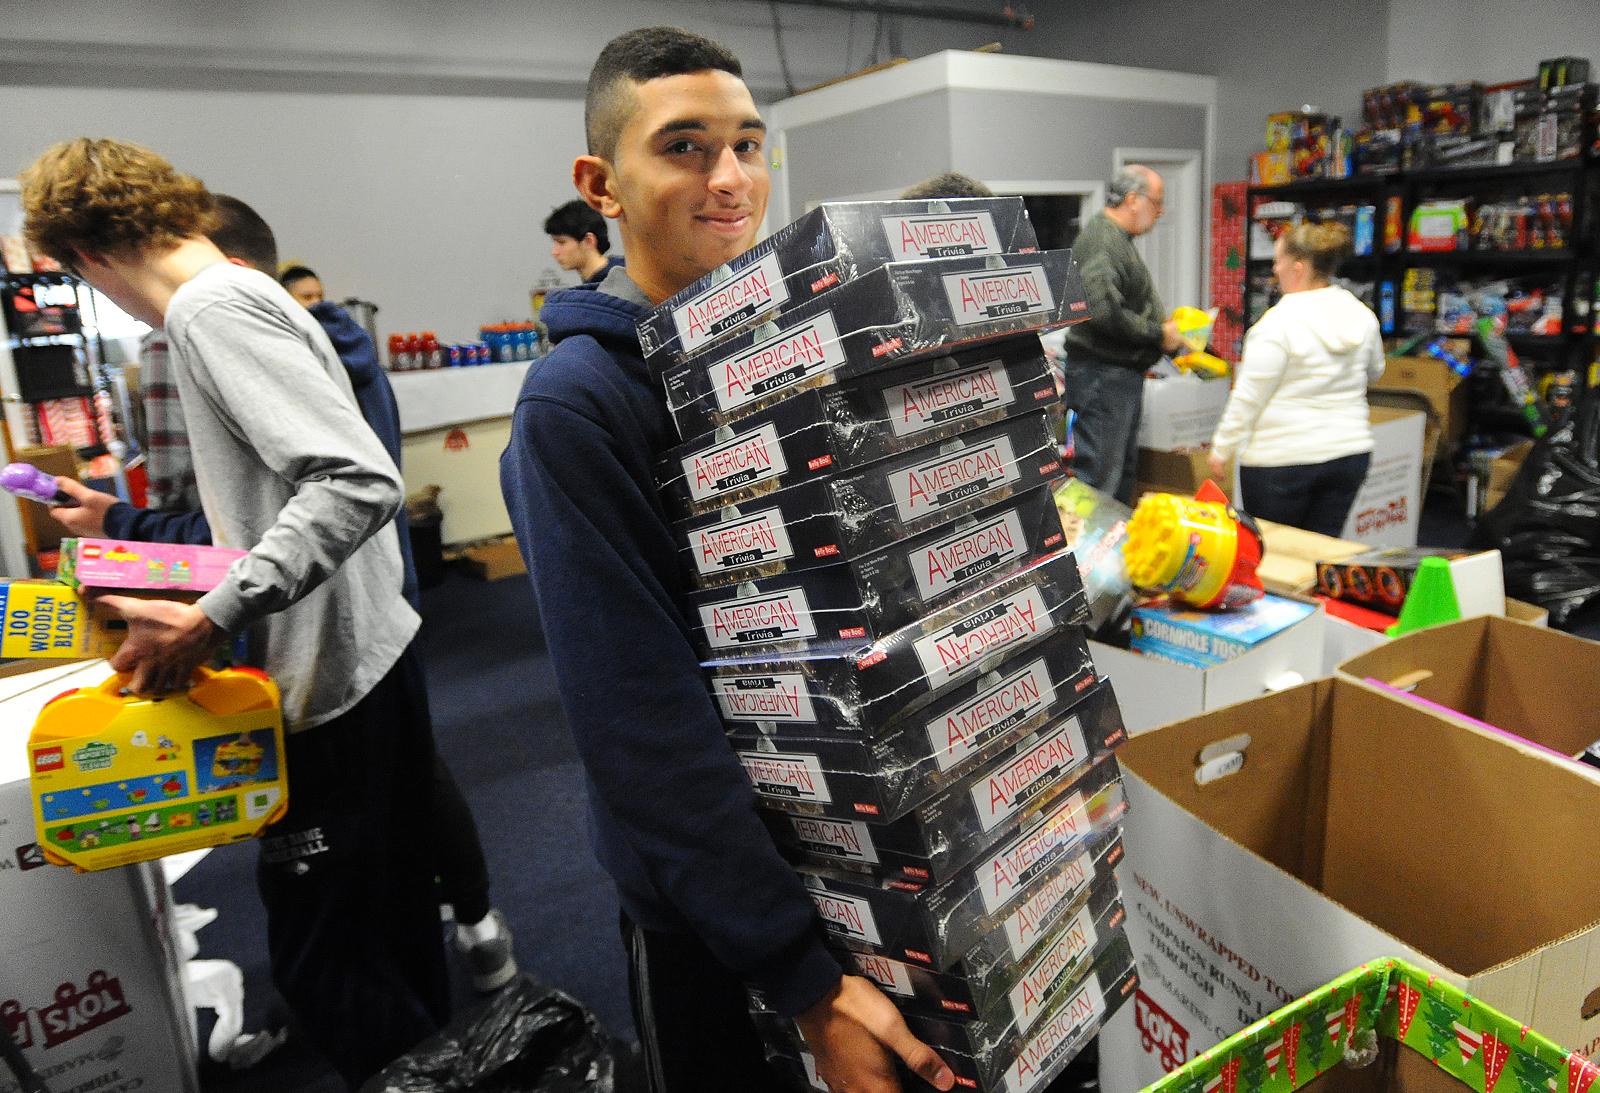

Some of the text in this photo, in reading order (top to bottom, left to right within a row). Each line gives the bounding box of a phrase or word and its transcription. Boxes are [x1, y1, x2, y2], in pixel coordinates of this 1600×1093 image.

[902, 220, 987, 253] AMERICAN
[936, 246, 965, 258] Trivia
[687, 270, 771, 339] AMERICAN
[960, 276, 1041, 312] AMERICAN
[995, 303, 1021, 316] Trivia
[718, 310, 748, 331] Trivia
[725, 331, 824, 397] AMERICAN
[761, 369, 795, 391] Trivia
[903, 371, 998, 422] AMERICAN
[941, 404, 973, 420] Trivia
[695, 439, 771, 489] AMERICAN
[722, 474, 749, 488] Trivia
[909, 449, 1004, 507] AMERICAN
[949, 484, 980, 501] Trivia
[701, 522, 777, 563] AMERICAN
[729, 553, 756, 564] Trivia
[928, 523, 1014, 585] AMERICAN
[964, 560, 993, 577] Trivia
[9, 610, 30, 636] 100
[30, 595, 54, 651] WOODEN
[54, 601, 77, 647] BLOCKS
[713, 600, 799, 638] AMERICAN
[744, 630, 774, 642] Trivia
[937, 599, 1038, 672] AMERICAN
[964, 610, 1000, 629] Trivia
[1145, 617, 1209, 653] CORNHOLE
[724, 686, 799, 717] AMERICAN
[741, 681, 769, 689] Trivia
[946, 674, 1040, 754] AMERICAN
[986, 717, 1017, 741] Trivia
[746, 761, 814, 792] MERICAN
[990, 732, 1075, 815] AMERICAN
[1023, 774, 1054, 798] Trivia
[993, 808, 1077, 898] AMERICAN
[1028, 852, 1057, 877] Trivia
[1015, 858, 1085, 944] AMERICAN
[1138, 902, 1251, 1006] CAMPAIGN RUNS
[1165, 899, 1260, 982] UNWRAPPED
[1023, 922, 1087, 1016] AMERICAN
[1150, 932, 1214, 998] THROUGH
[46, 990, 121, 1033] TOYS
[1016, 991, 1093, 1087] AMERICAN
[1137, 999, 1185, 1063] TOYS
